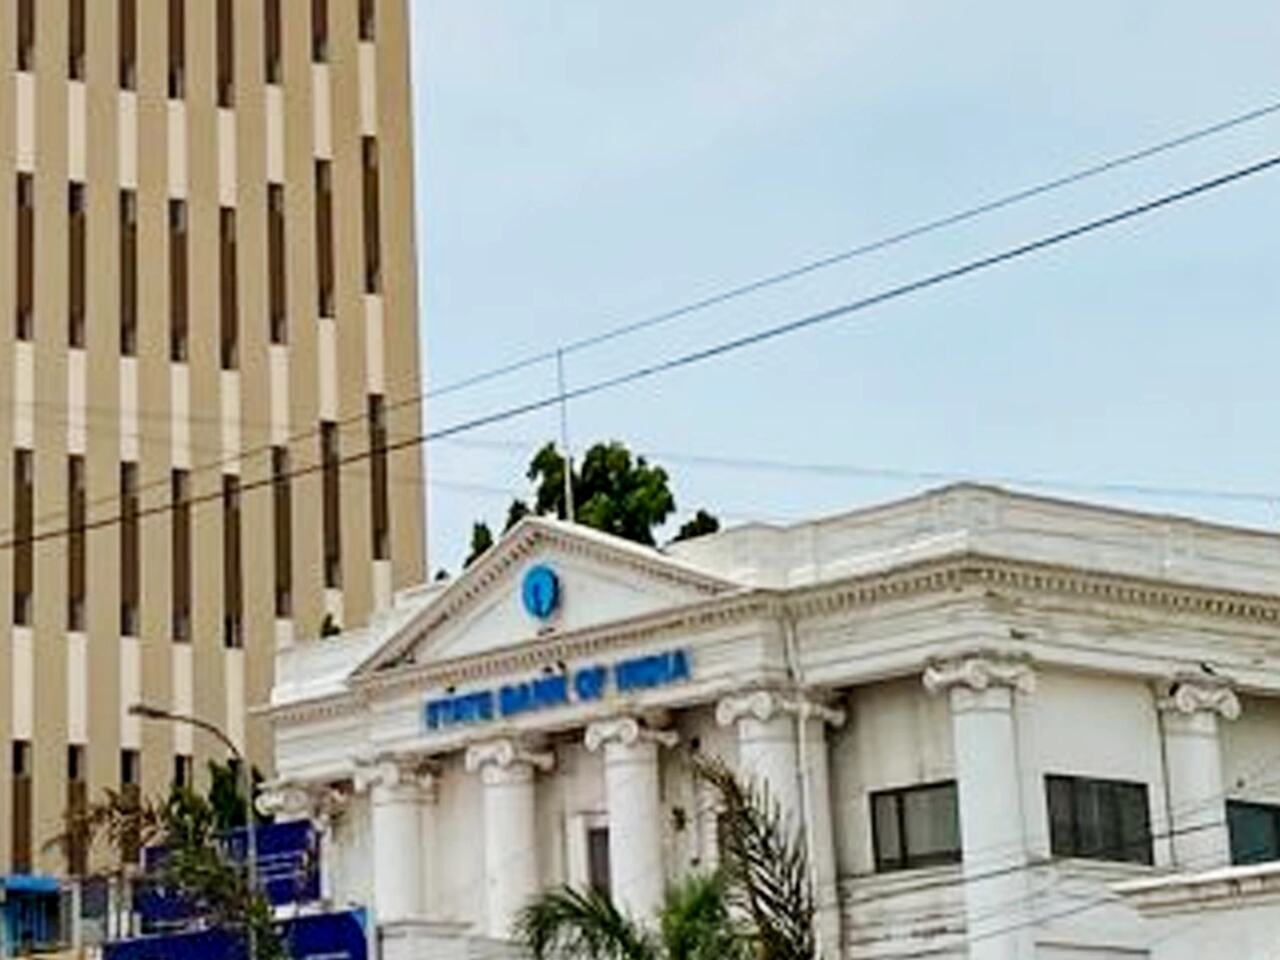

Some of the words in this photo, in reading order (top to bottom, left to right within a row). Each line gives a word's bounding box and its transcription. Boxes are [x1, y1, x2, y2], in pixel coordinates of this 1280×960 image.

[426, 691, 494, 728] STATE
[499, 675, 567, 715] BANK
[575, 667, 607, 699] OF
